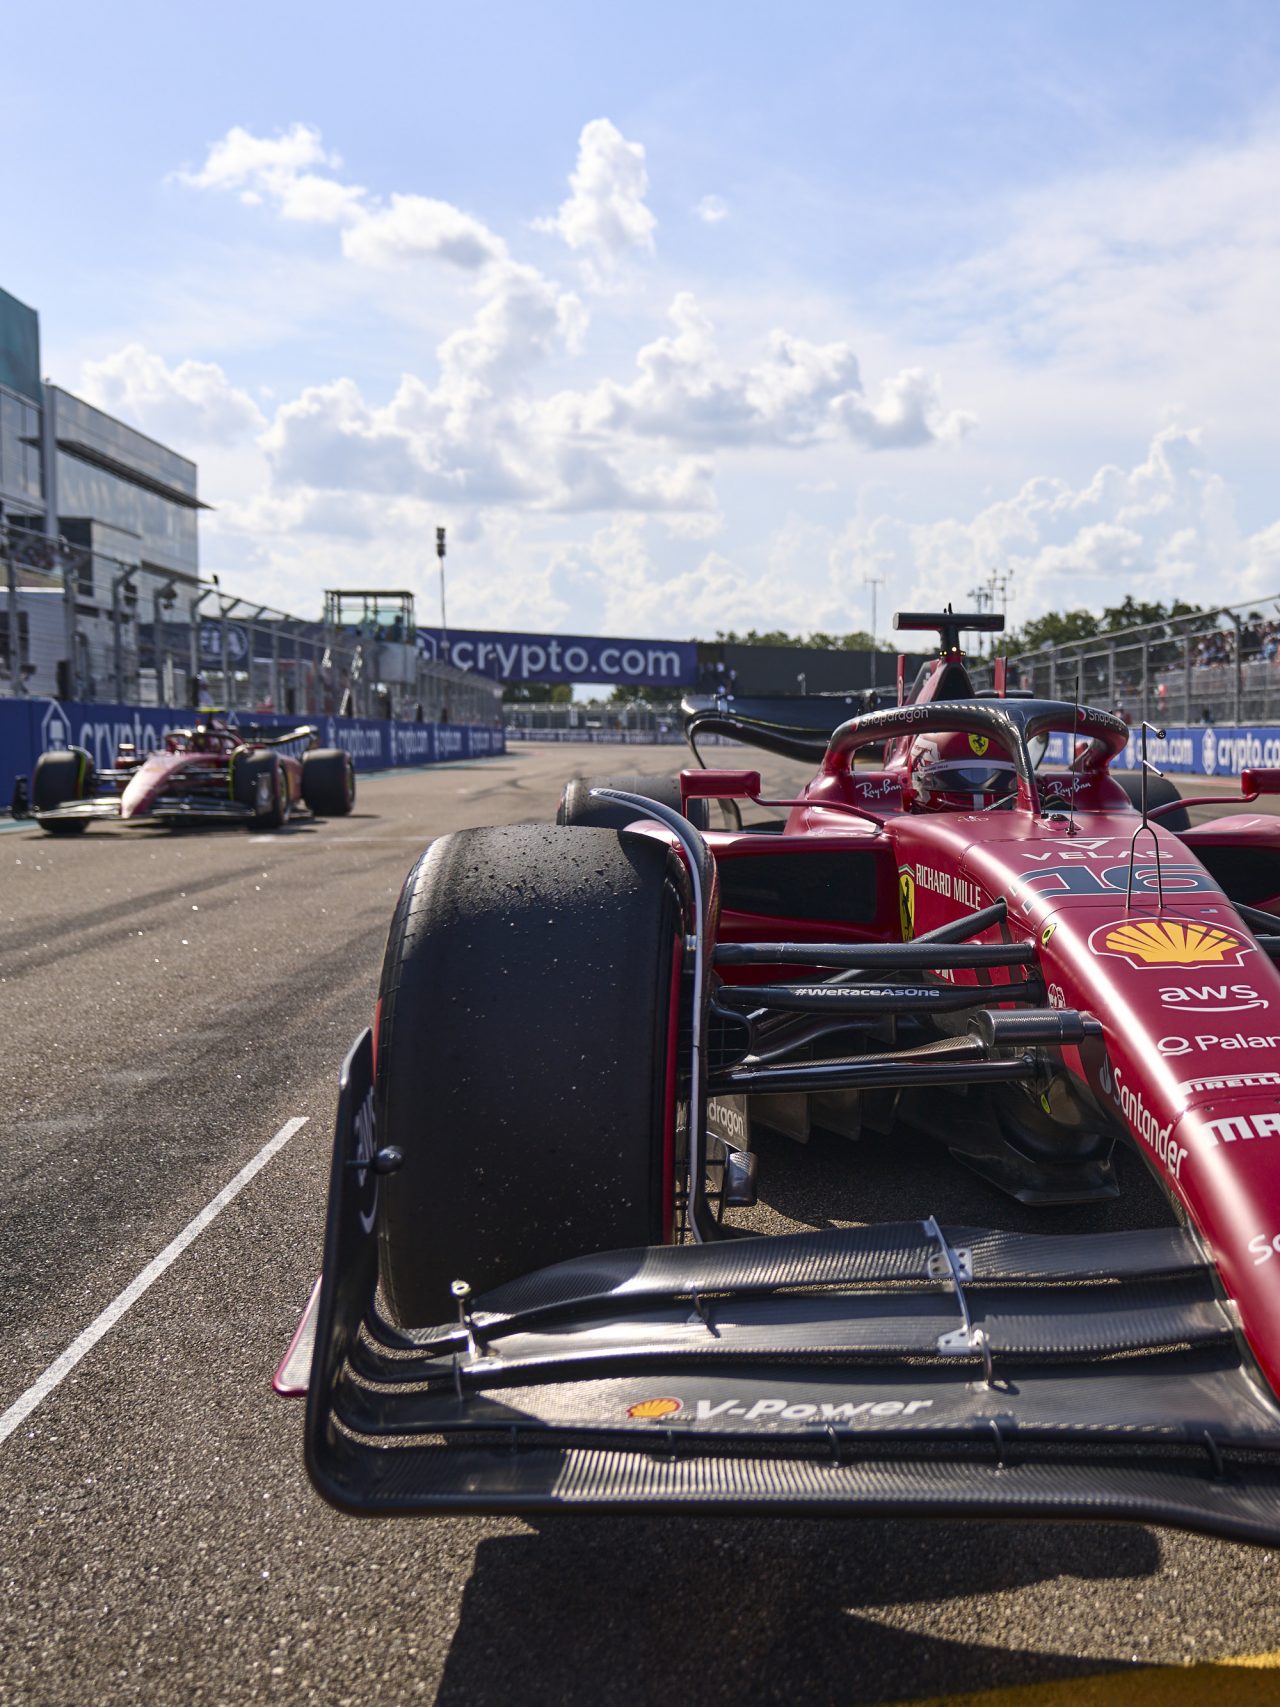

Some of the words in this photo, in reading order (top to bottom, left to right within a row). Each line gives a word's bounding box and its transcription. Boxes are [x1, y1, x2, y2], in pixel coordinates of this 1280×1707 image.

[452, 638, 681, 679] crypto.com
[915, 863, 951, 897] RICHARD
[953, 877, 982, 911] MILLE
[1009, 864, 1226, 914] 16
[795, 987, 940, 998] #WeRaceAsOne
[1159, 984, 1259, 1002] aws
[1114, 1067, 1188, 1179] Santander
[697, 1399, 934, 1420] V-Power
